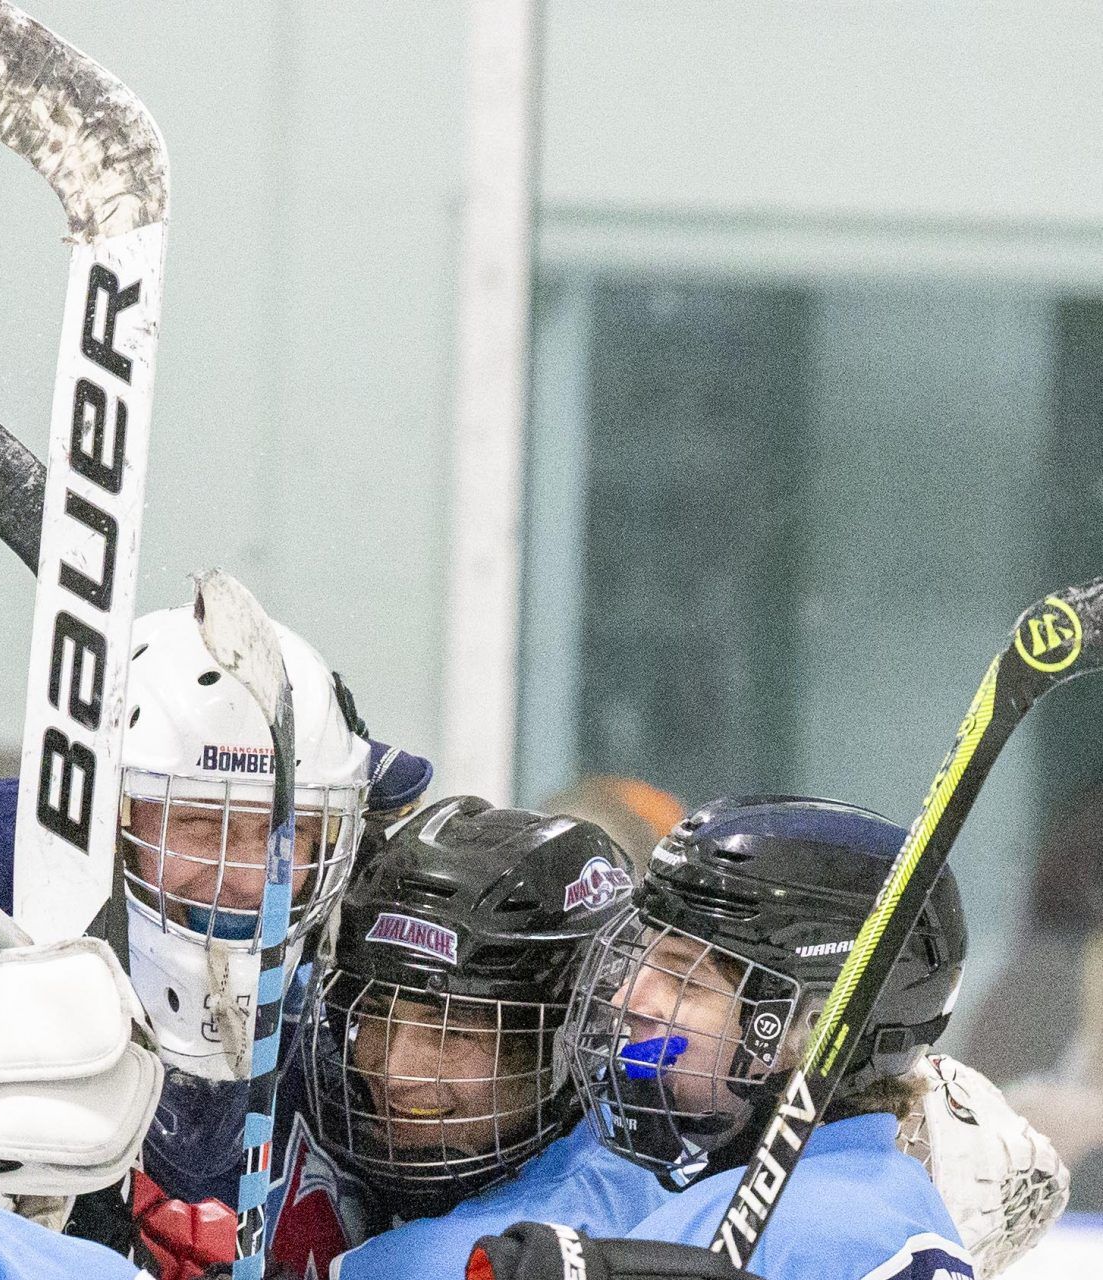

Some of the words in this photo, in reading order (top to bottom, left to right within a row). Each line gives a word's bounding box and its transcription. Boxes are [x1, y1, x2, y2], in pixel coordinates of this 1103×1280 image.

[36, 262, 142, 857] BAUER
[370, 916, 456, 958] AVALANCHE
[795, 939, 855, 957] WARRI
